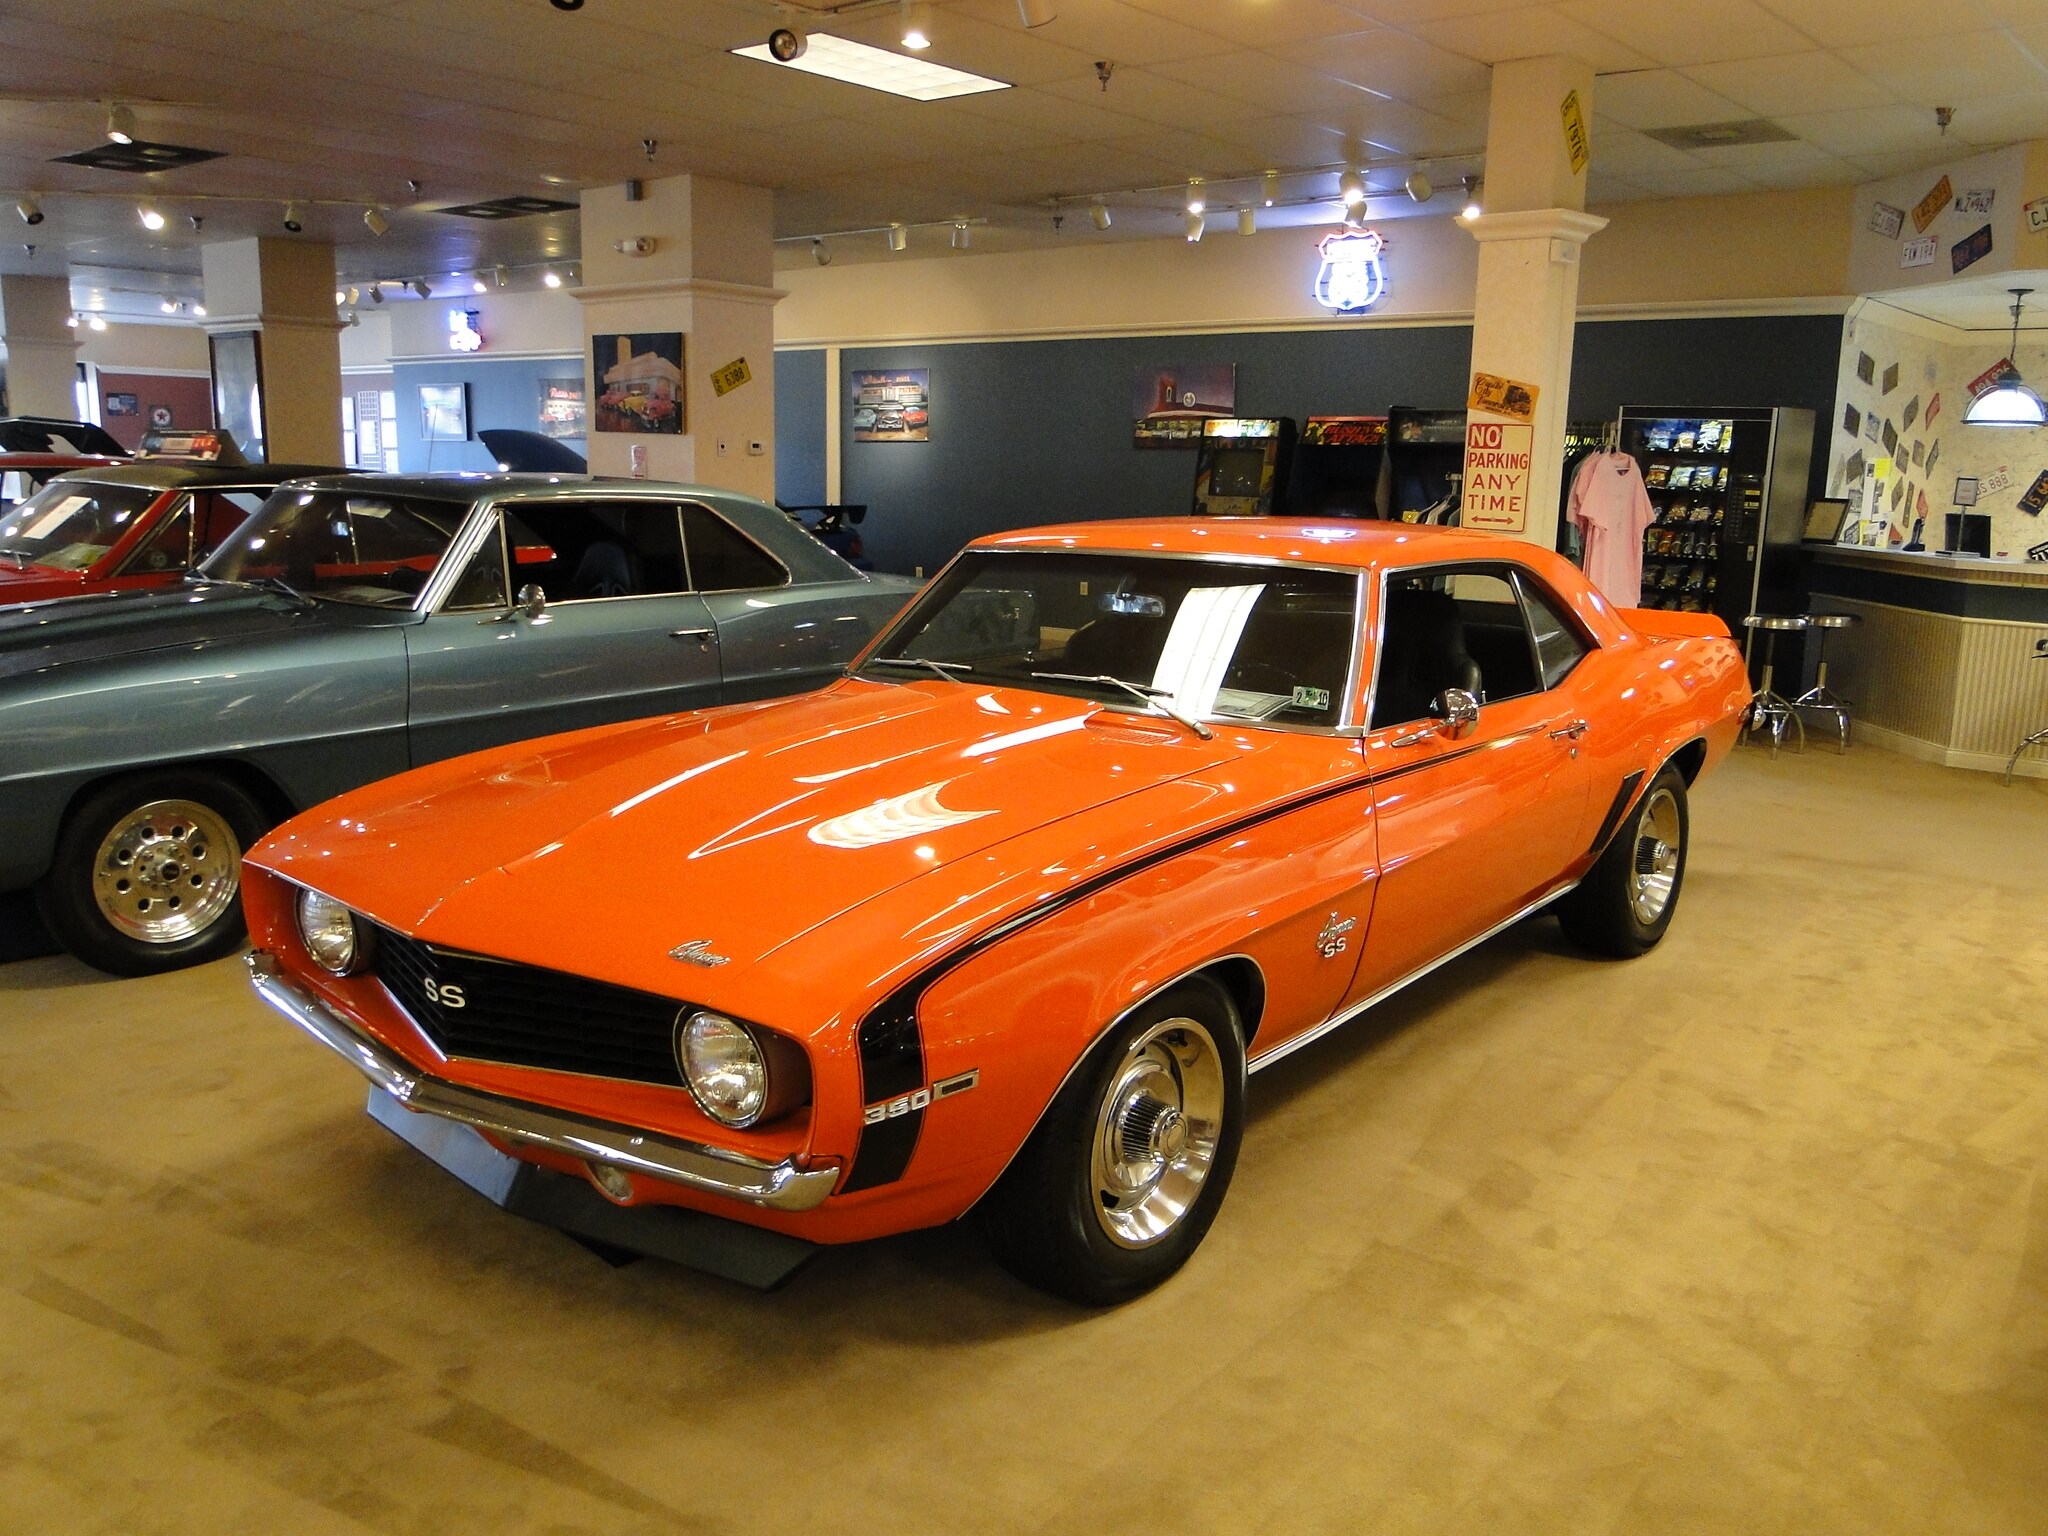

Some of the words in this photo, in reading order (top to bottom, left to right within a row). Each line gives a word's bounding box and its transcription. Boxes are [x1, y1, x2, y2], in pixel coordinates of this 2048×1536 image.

[1470, 425, 1501, 448] NO
[1468, 452, 1529, 470] PARKING
[1471, 473, 1521, 491] ANY
[1988, 473, 2009, 490] 888
[1468, 494, 1521, 512] TIME
[1296, 691, 1303, 704] 2
[1317, 691, 1328, 706] 10
[1324, 937, 1346, 958] SS
[423, 977, 466, 1008] SS
[863, 1089, 931, 1126] 350
